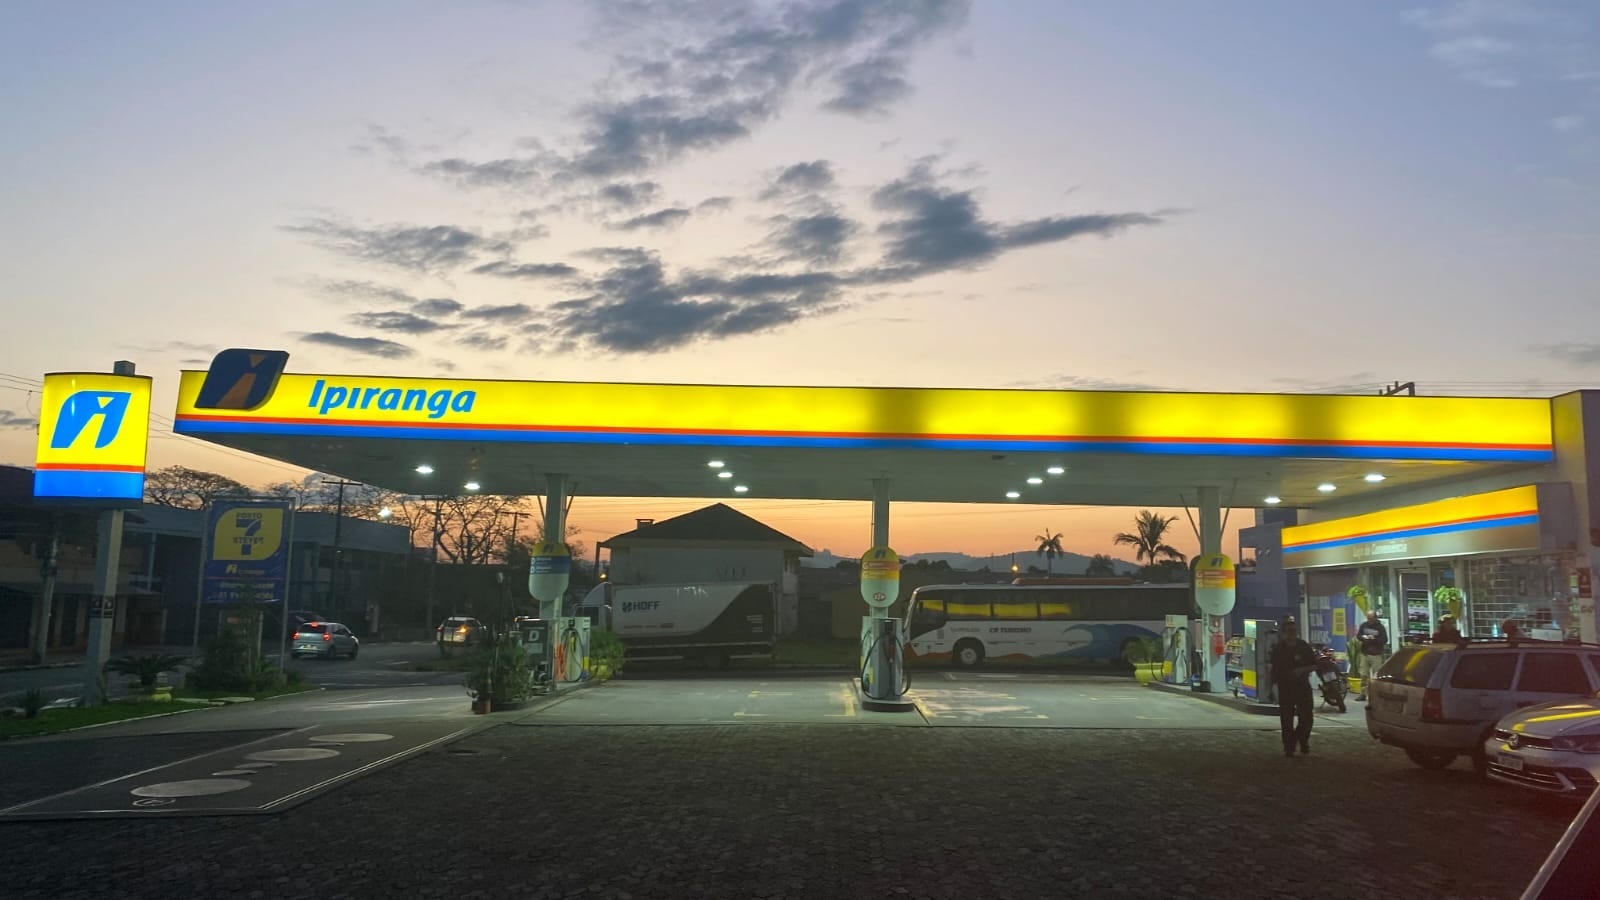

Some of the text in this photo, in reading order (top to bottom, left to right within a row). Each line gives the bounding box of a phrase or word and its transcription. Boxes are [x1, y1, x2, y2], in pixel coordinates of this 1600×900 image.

[308, 379, 477, 419] Ipiranga
[236, 518, 263, 556] 7
[633, 601, 662, 611] HOFF
[527, 630, 540, 642] D
